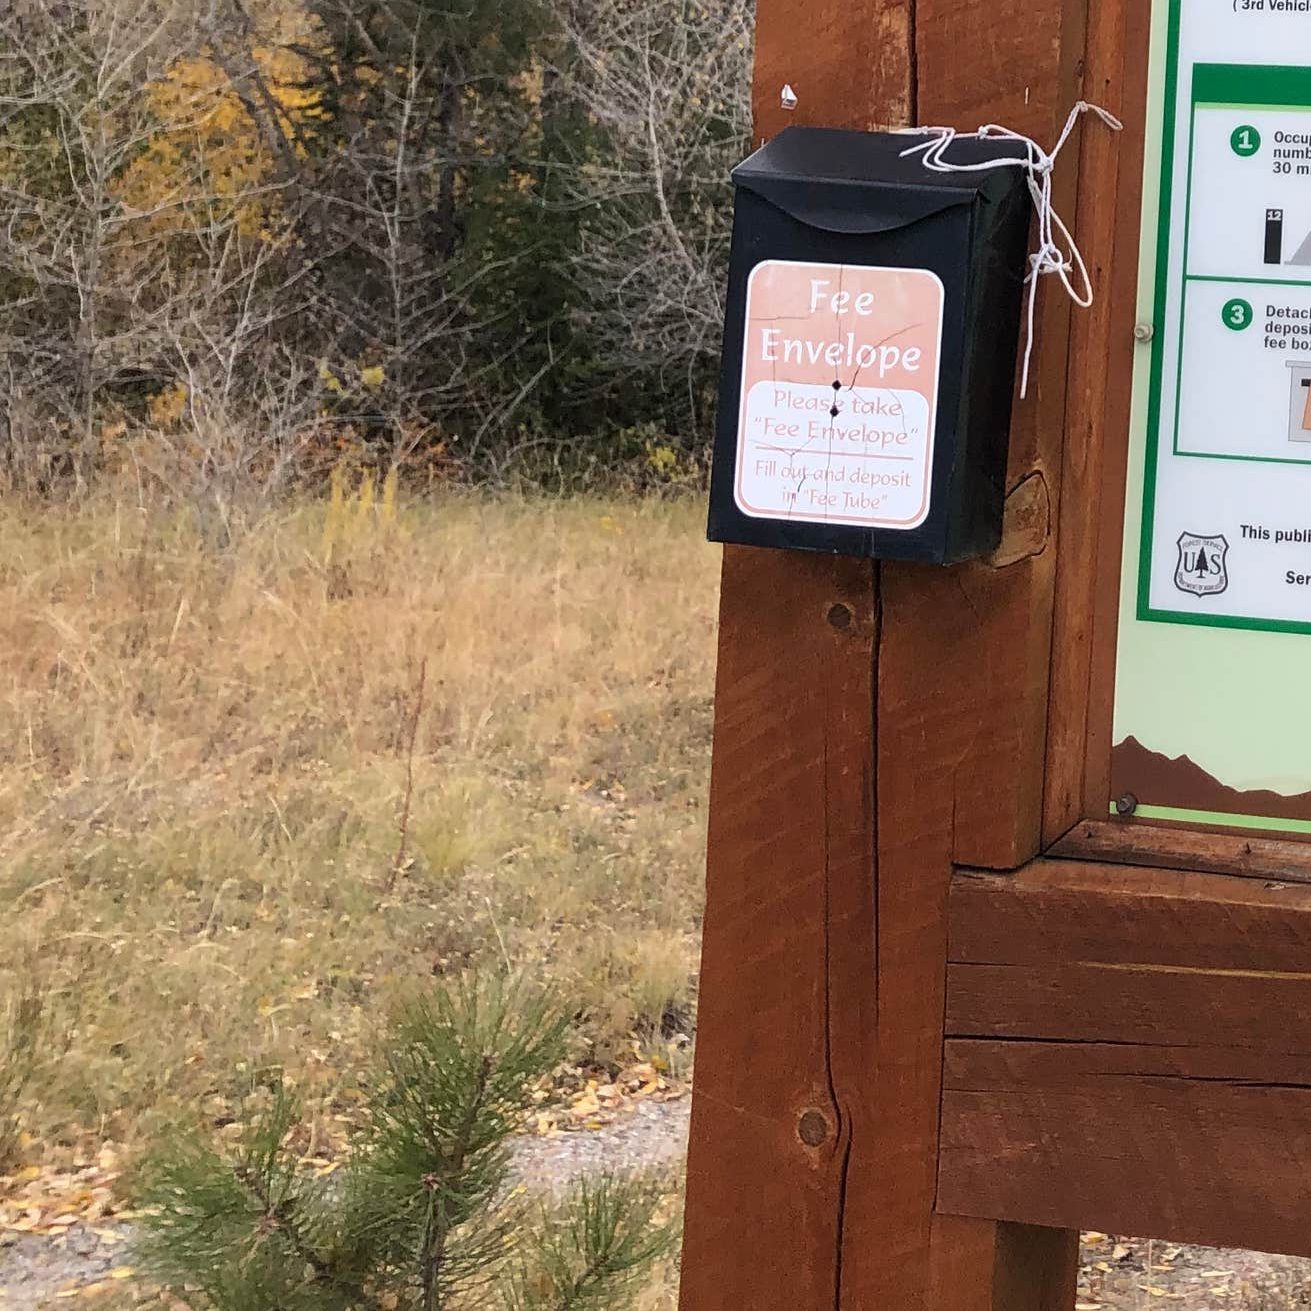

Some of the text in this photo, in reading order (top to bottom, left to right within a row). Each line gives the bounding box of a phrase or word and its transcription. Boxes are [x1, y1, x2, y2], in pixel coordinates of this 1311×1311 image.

[1238, 130, 1252, 148] 1
[1273, 162, 1291, 173] 30
[810, 280, 873, 316] Fee
[1230, 305, 1243, 323] 3
[1264, 336, 1286, 348] fee
[761, 328, 920, 377] Envelope
[852, 396, 903, 417] take
[808, 419, 917, 446] Envelope"
